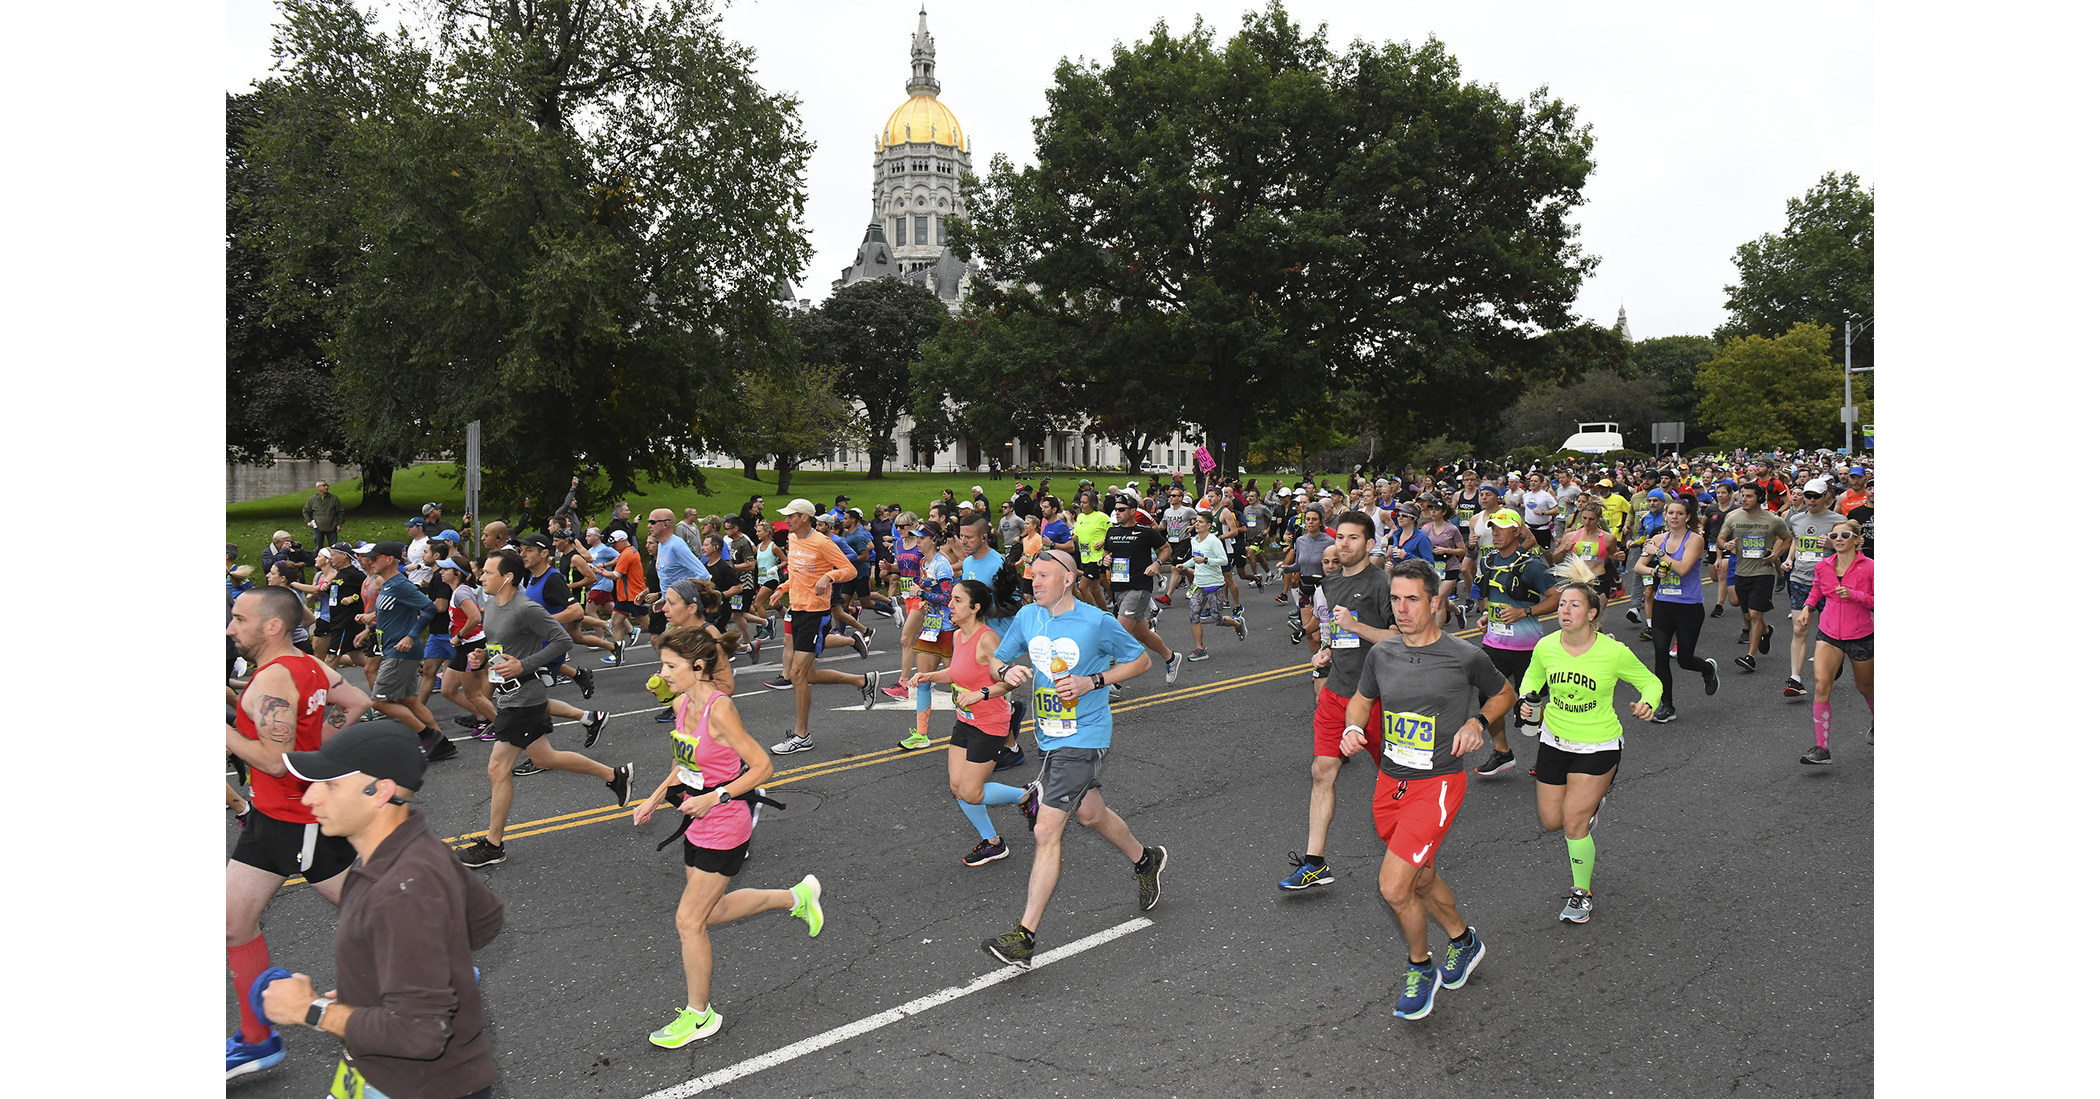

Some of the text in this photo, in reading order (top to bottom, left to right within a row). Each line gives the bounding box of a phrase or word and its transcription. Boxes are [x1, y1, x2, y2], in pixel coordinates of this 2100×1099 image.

[1549, 671, 1597, 692] MILFORD
[1036, 692, 1071, 713] 158
[1564, 700, 1597, 713] RUNNERS
[1386, 714, 1433, 742] 1473
